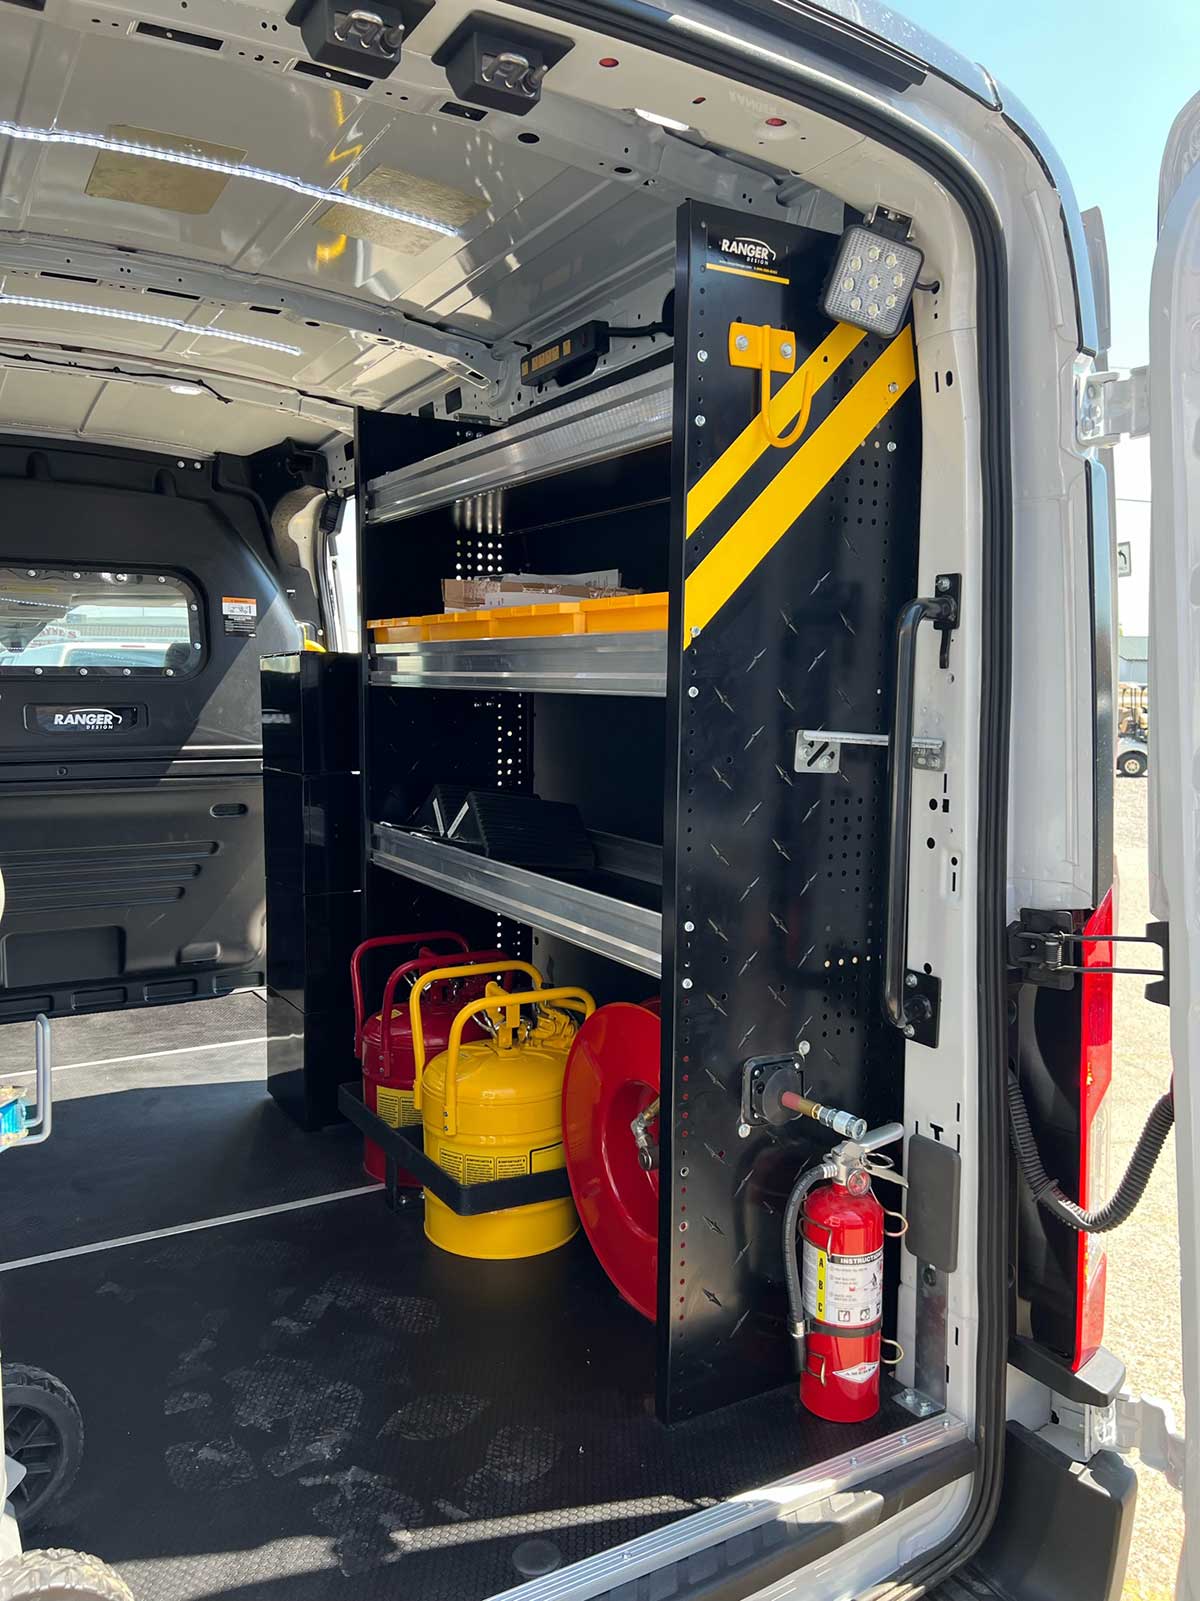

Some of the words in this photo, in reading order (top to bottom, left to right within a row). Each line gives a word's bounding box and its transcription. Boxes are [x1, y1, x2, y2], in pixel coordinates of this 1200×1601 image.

[721, 239, 769, 259] RANGER
[746, 256, 769, 265] DESIGN
[53, 713, 114, 725] RANGER
[818, 1257, 824, 1269] A
[818, 1279, 824, 1290] B
[817, 1302, 823, 1313] C
